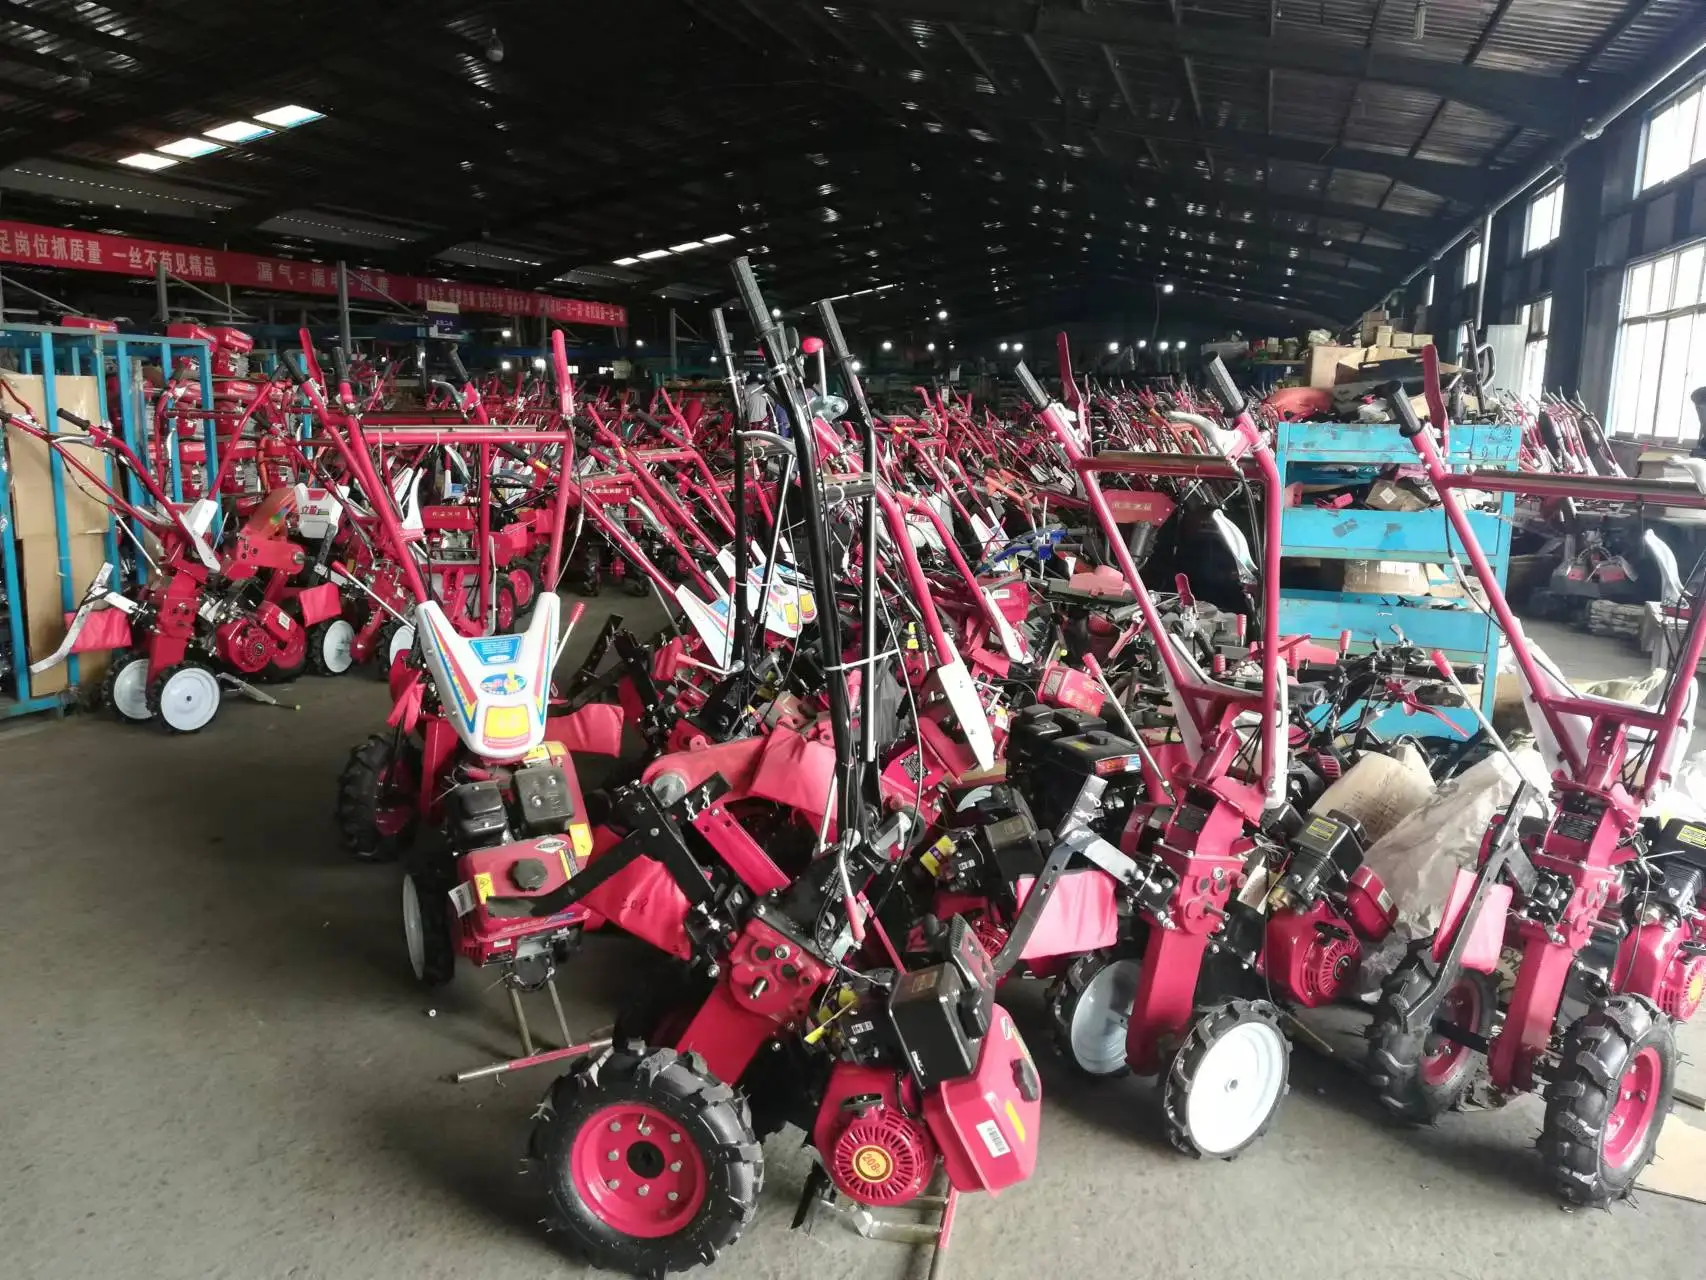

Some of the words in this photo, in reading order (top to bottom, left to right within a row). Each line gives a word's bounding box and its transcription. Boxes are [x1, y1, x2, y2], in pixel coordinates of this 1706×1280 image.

[0, 229, 103, 265] 足岗位抓质量
[112, 246, 217, 278] 一丝不苟见精品
